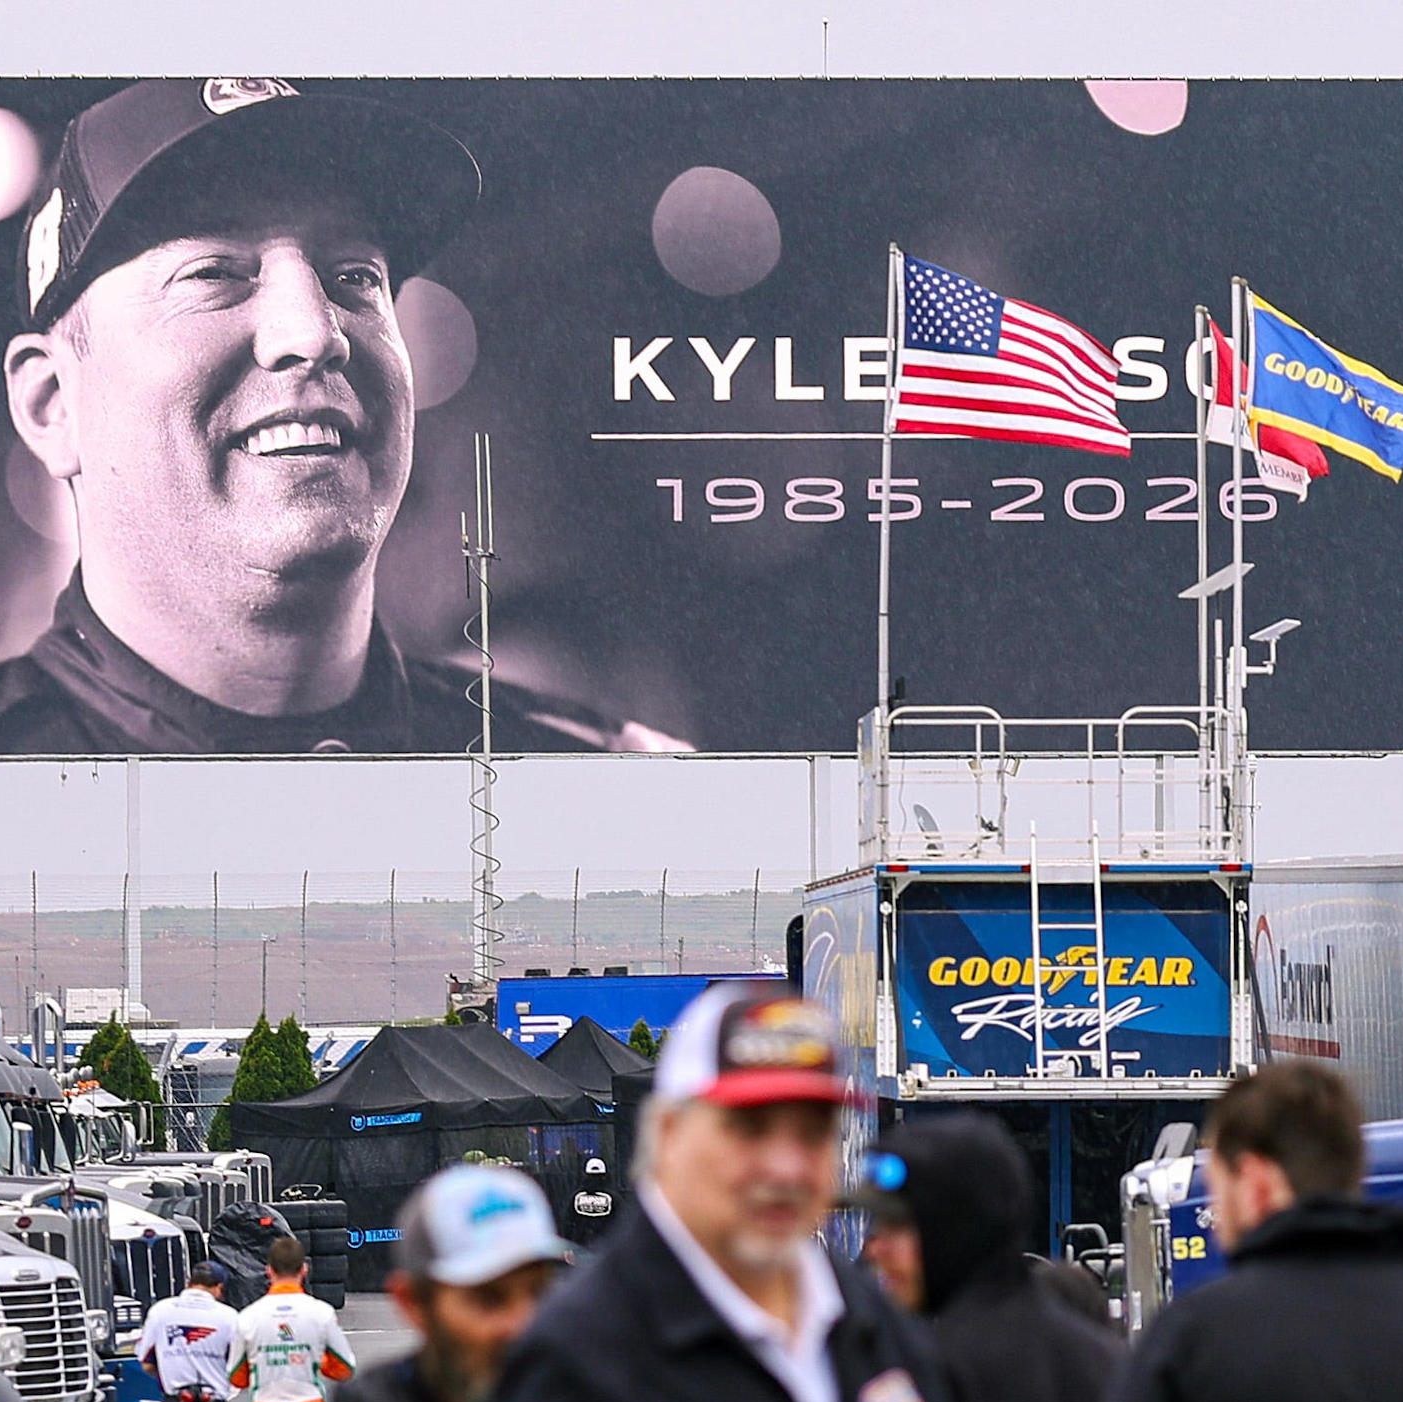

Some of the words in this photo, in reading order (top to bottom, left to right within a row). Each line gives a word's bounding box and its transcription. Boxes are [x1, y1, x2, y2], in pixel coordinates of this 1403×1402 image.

[613, 337, 895, 401] KYLE
[656, 477, 1278, 522] 1985-2026
[928, 955, 1195, 988] GOODYEAR
[951, 991, 1164, 1047] Racing
[1171, 1235, 1207, 1260] 52
